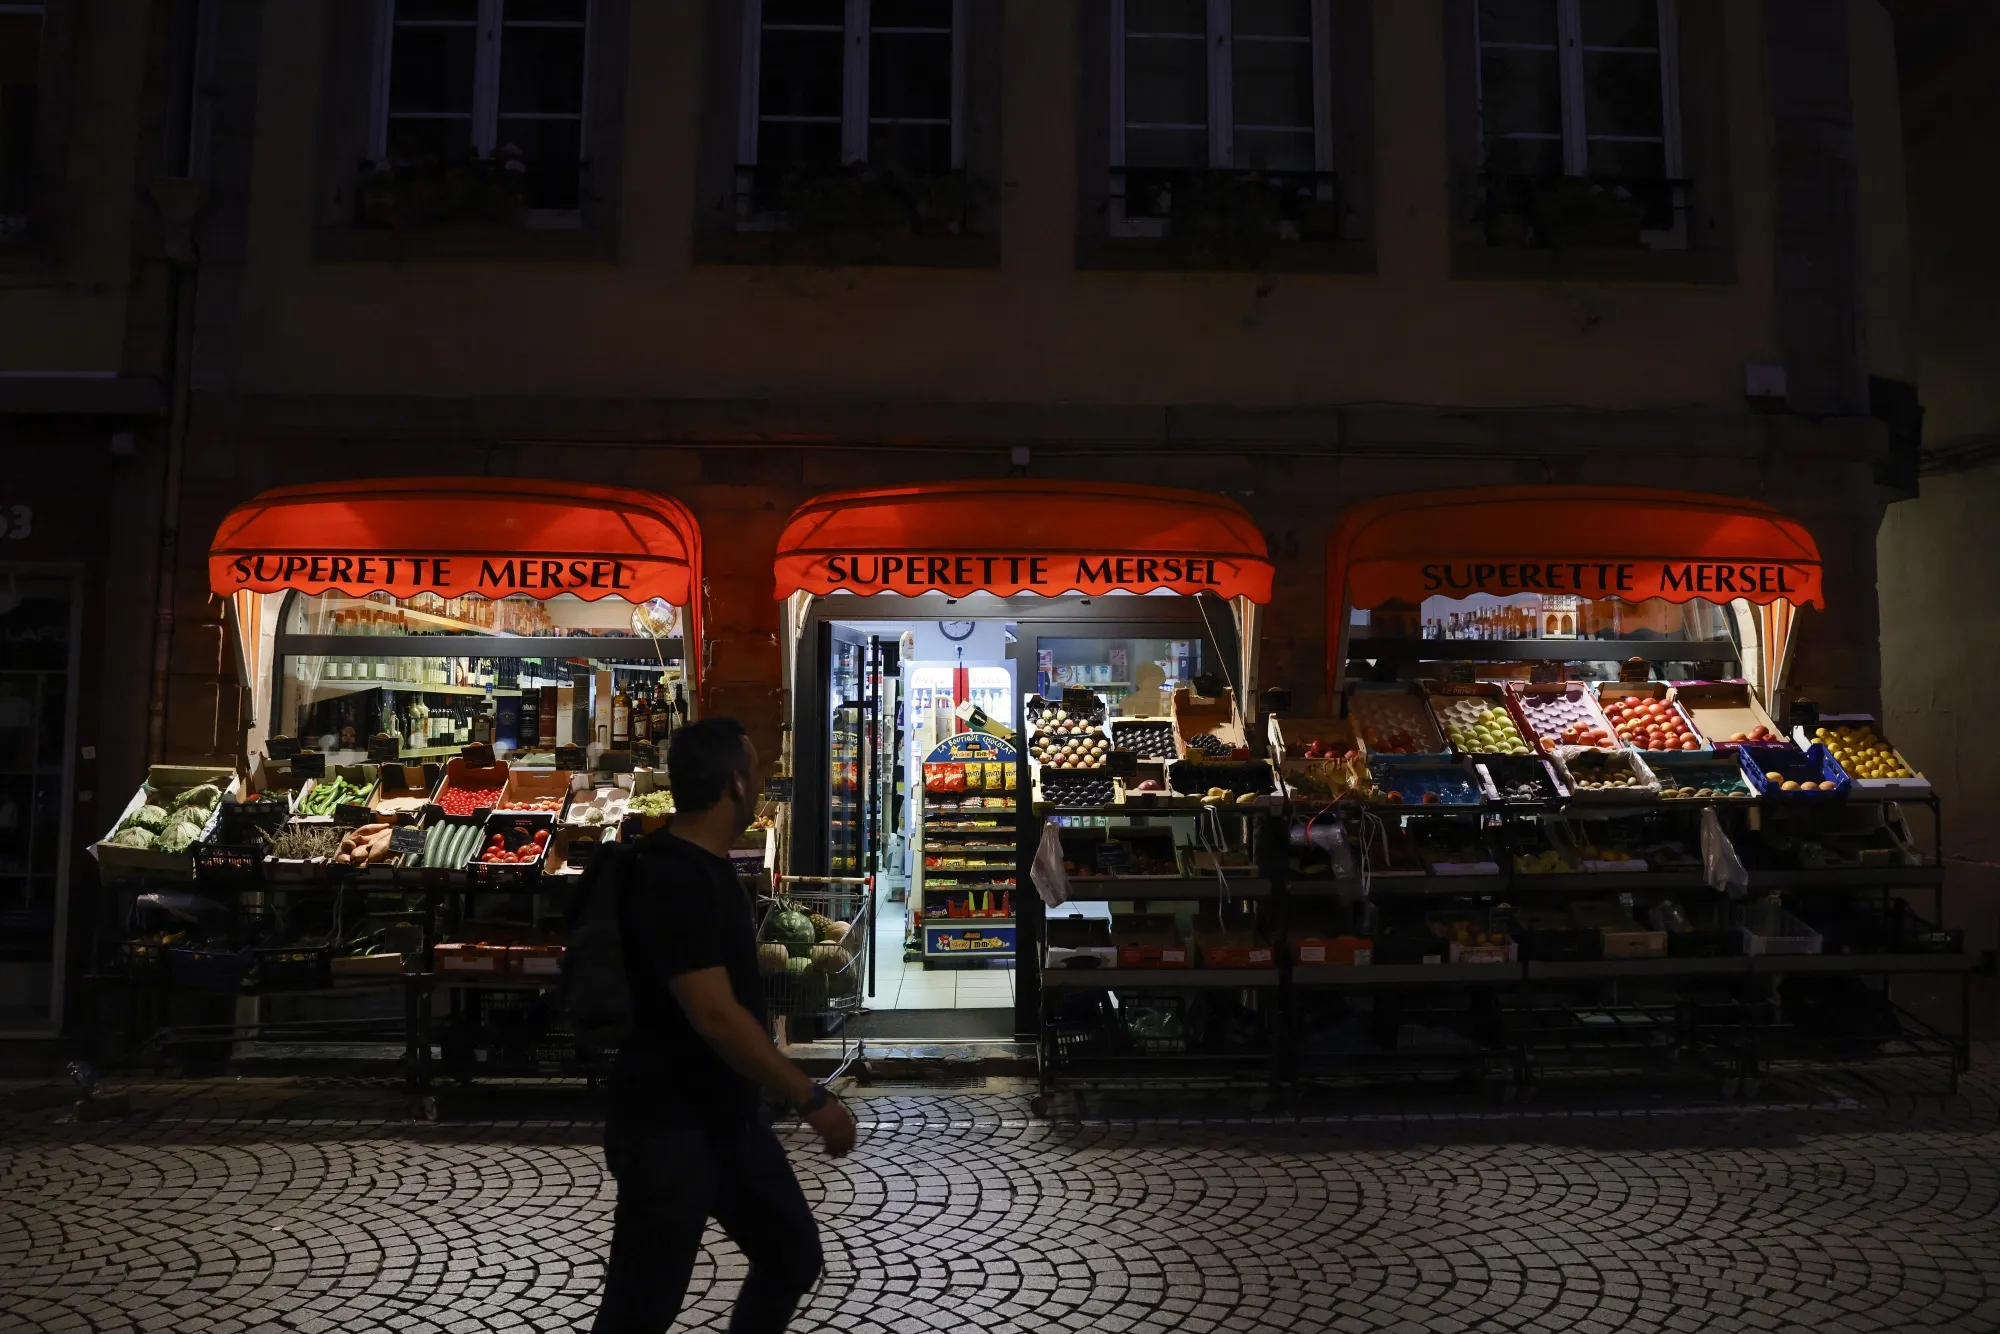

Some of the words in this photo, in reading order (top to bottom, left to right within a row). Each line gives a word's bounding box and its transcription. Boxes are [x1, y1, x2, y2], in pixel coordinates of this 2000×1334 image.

[234, 556, 451, 587] SUPERETTE
[478, 559, 630, 589] MERSEL
[826, 556, 1048, 585] SUPERETTE
[1076, 557, 1222, 585] MERSEL
[1421, 563, 1635, 591] SUPERETTE
[1660, 564, 1796, 593] MERSEL
[937, 744, 948, 753] LA
[947, 734, 980, 747] BOUTIQUE
[982, 735, 1014, 755] CHOCOLAT
